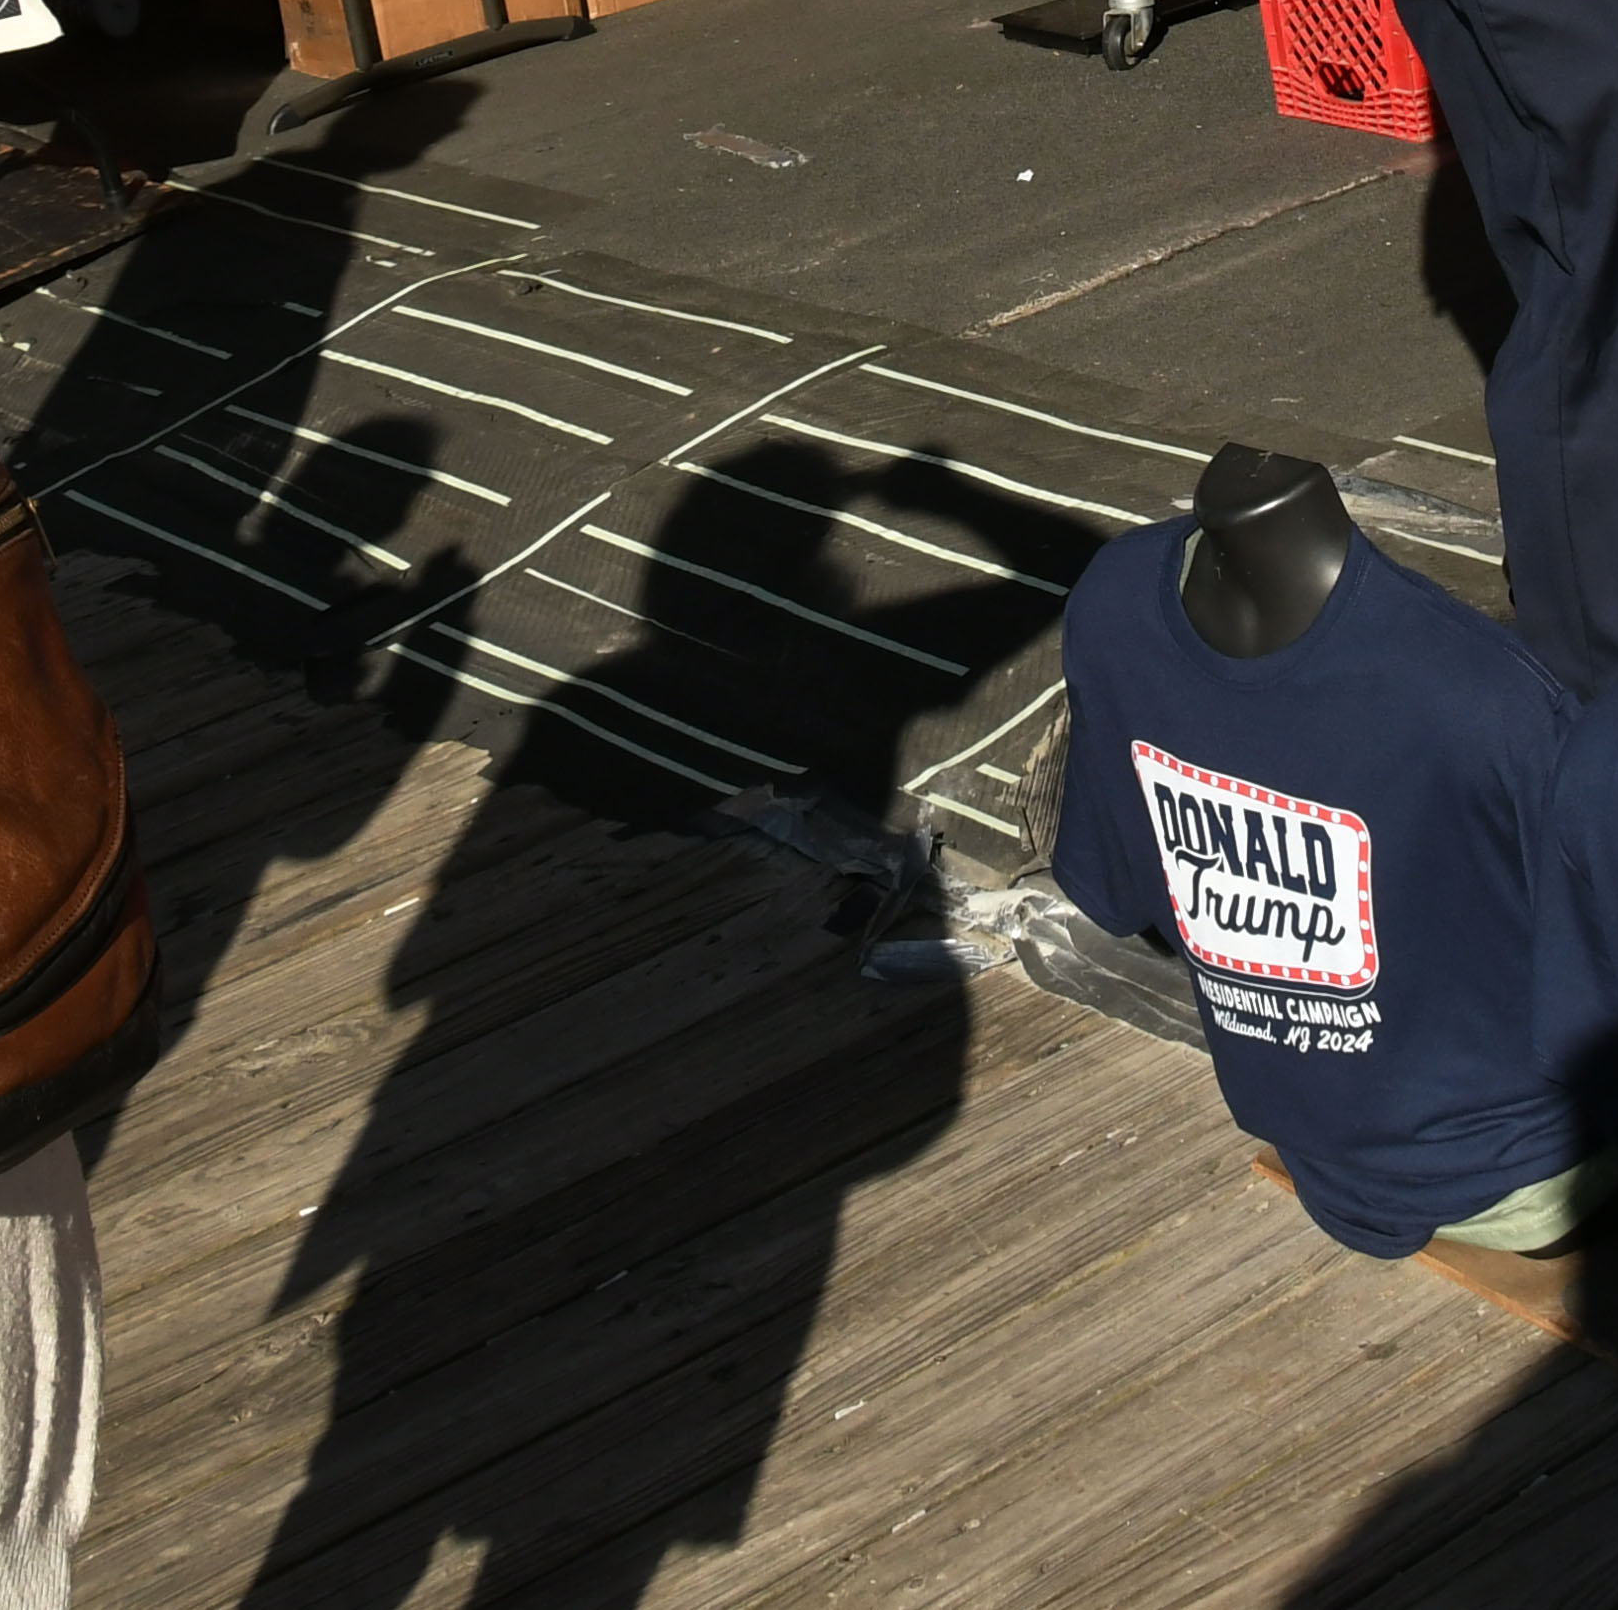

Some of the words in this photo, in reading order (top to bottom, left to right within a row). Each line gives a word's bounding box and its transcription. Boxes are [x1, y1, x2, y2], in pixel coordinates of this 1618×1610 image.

[1154, 781, 1337, 903] DONALD
[1175, 849, 1346, 963] Trump
[1198, 972, 1284, 1020] PRESIDENTIAL
[1286, 997, 1382, 1029] CAMPAIGN
[1211, 1004, 1278, 1045] Wildwood,
[1283, 1025, 1312, 1053] NJ
[1317, 1028, 1374, 1054] 2024
